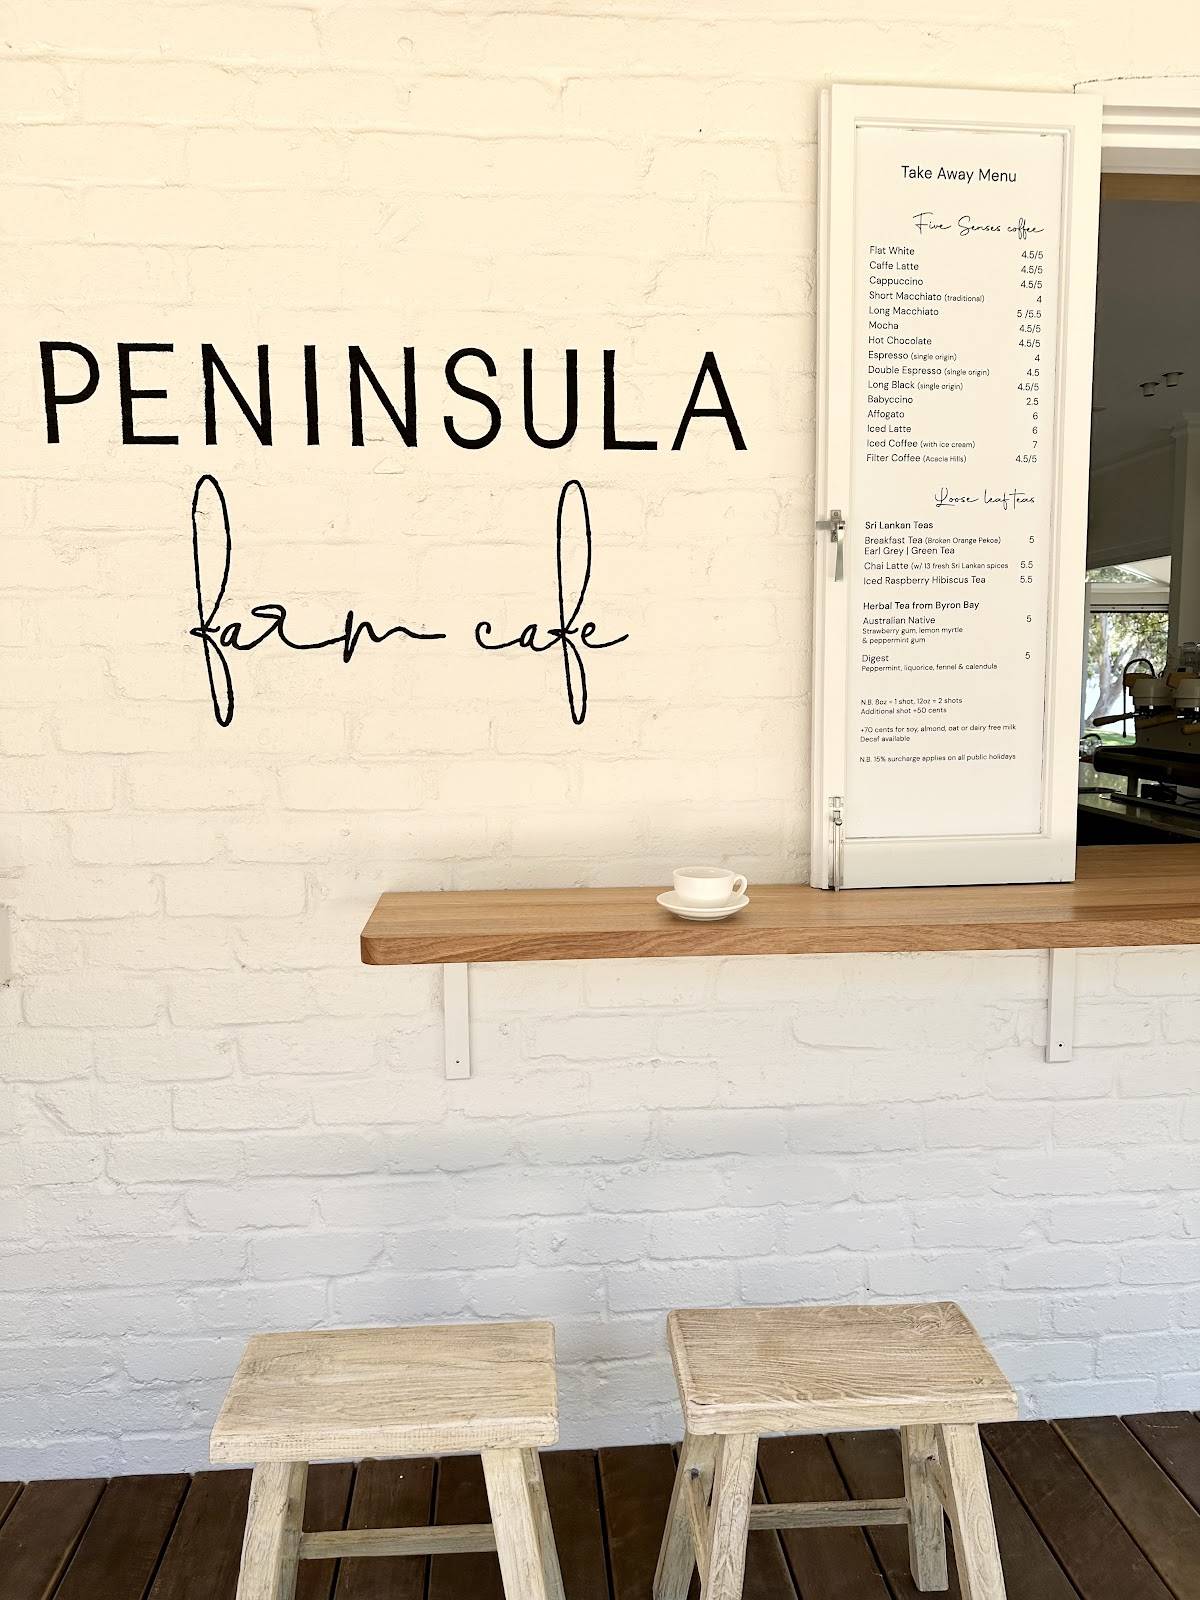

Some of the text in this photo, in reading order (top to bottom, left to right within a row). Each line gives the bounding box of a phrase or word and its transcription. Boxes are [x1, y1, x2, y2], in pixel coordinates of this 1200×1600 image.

[902, 166, 1017, 184] Take Away Menu
[913, 212, 1044, 240] Five Senses coffee
[870, 246, 1044, 260] Flat White 4.5/5
[870, 261, 1043, 274] Caffe Latte 4.5/5
[870, 276, 1042, 289] Cappuccino 4.5/5
[869, 291, 893, 299] Short
[896, 292, 942, 301] Macchiato
[945, 294, 985, 303] (traditional)
[869, 307, 890, 317] Long
[893, 307, 939, 316] Macchiato
[869, 321, 1041, 333] Mocha 4.5/5
[869, 336, 1041, 348] Hot Chocolate 4.5/5
[868, 351, 908, 360] Espresso
[911, 353, 933, 361] (single
[935, 353, 957, 361] origin)
[868, 366, 1040, 377] Double Espresso (single origin) 4.5
[868, 381, 1039, 391] Long Black (single origin) 4.5/5
[39, 340, 748, 452] PENINSULA
[868, 395, 914, 405] Babyccino
[868, 410, 1038, 420] Affogato 6
[867, 424, 886, 433] Iced
[889, 424, 911, 433] Latte
[867, 439, 886, 448] Iced
[889, 439, 918, 448] Coffee
[867, 454, 1037, 463] Filter Coffee (Acacia Hills) 4.5/5
[935, 487, 1035, 511] Loose leaf teas
[865, 537, 905, 545] Breakfast
[925, 537, 951, 545] (Broken
[952, 537, 977, 545] Orange
[1029, 536, 1035, 544] 5
[864, 547, 881, 555] Earl
[883, 547, 904, 556] Grey
[911, 547, 938, 555] Green
[864, 562, 884, 570] Chai
[886, 562, 909, 570] Latte
[1020, 561, 1034, 569] 5.5
[864, 577, 883, 585] Iced
[885, 577, 930, 586] Raspberry
[932, 576, 969, 584] Hibiscus
[189, 474, 629, 728] farm cafe
[863, 602, 892, 610] Herbal
[894, 602, 910, 610] Tea
[936, 601, 961, 611] Byron
[964, 601, 980, 610] Bay
[863, 615, 1032, 625] Australian Native 5
[863, 628, 900, 636] Strawberry
[870, 637, 909, 645] peppermint
[862, 654, 889, 664] Digest
[970, 724, 987, 732] dairy
[860, 735, 880, 743] Decaf
[888, 755, 921, 763] surcharge
[989, 753, 1016, 761] holidays
